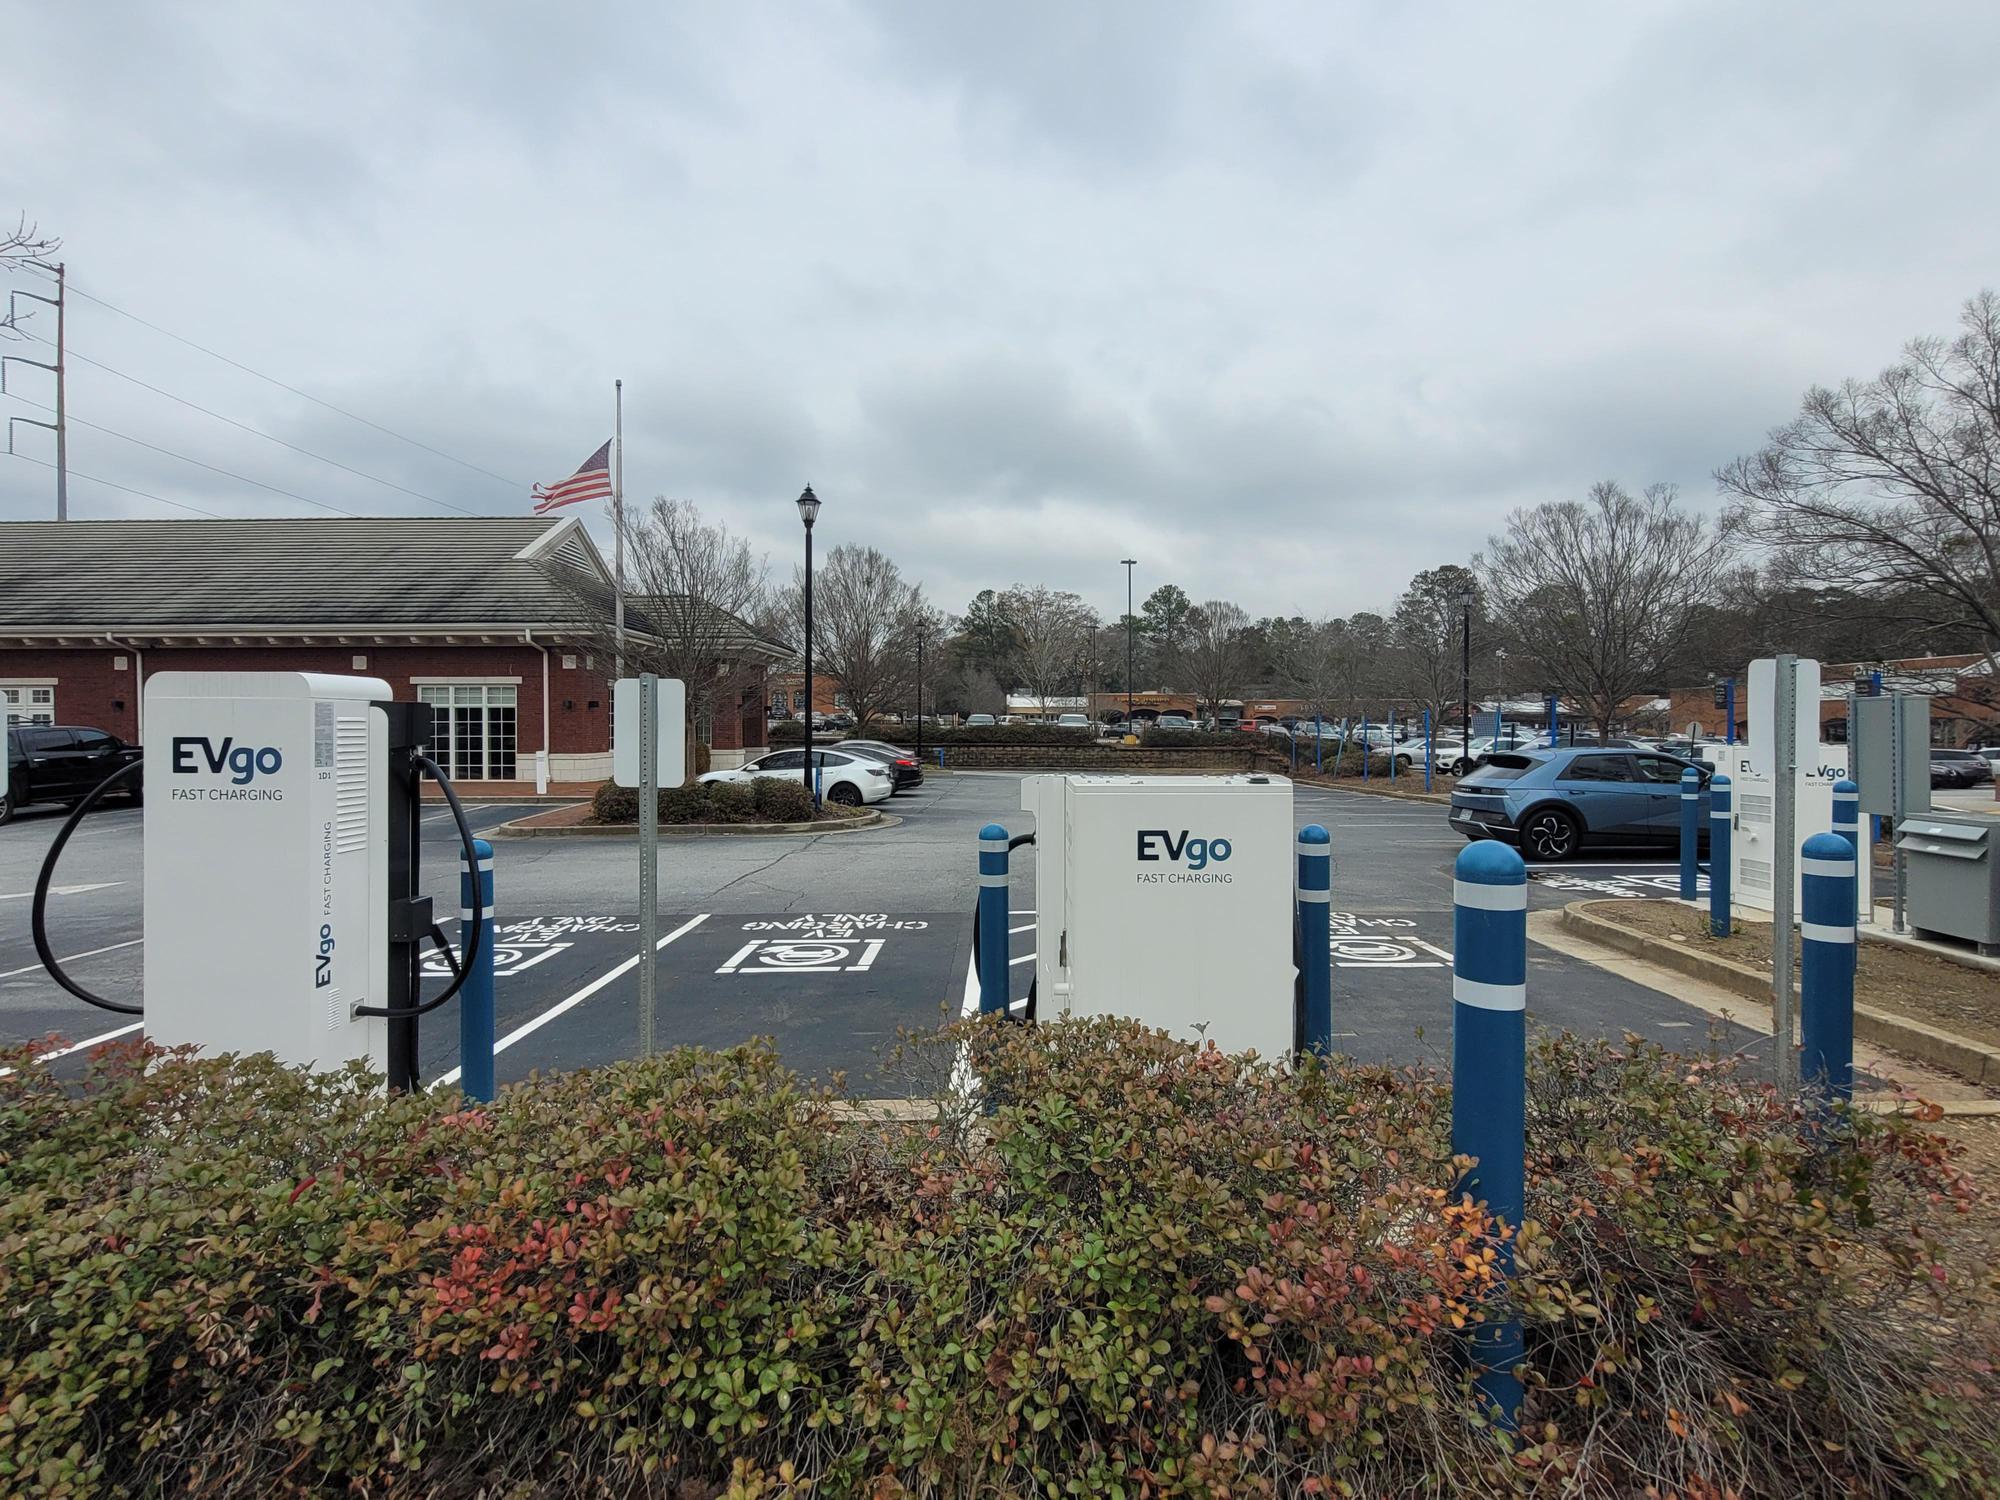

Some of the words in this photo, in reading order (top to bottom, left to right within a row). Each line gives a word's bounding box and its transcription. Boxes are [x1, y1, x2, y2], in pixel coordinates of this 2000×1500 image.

[173, 737, 283, 785] EVgo
[1806, 765, 1846, 781] Vgo
[172, 789, 205, 801] FAST
[209, 789, 283, 801] CHARGING
[324, 821, 332, 884] CHARGING
[1137, 830, 1233, 870] EVgo
[1137, 874, 1165, 883] FAST
[1168, 874, 1233, 883] CHARGING
[324, 888, 332, 916] FAST
[517, 916, 617, 925] ONLY
[794, 913, 888, 922] ONLY
[741, 921, 929, 930] CHARGING
[501, 933, 562, 942] EV
[801, 929, 854, 938] EV
[316, 924, 335, 988] EVgo
